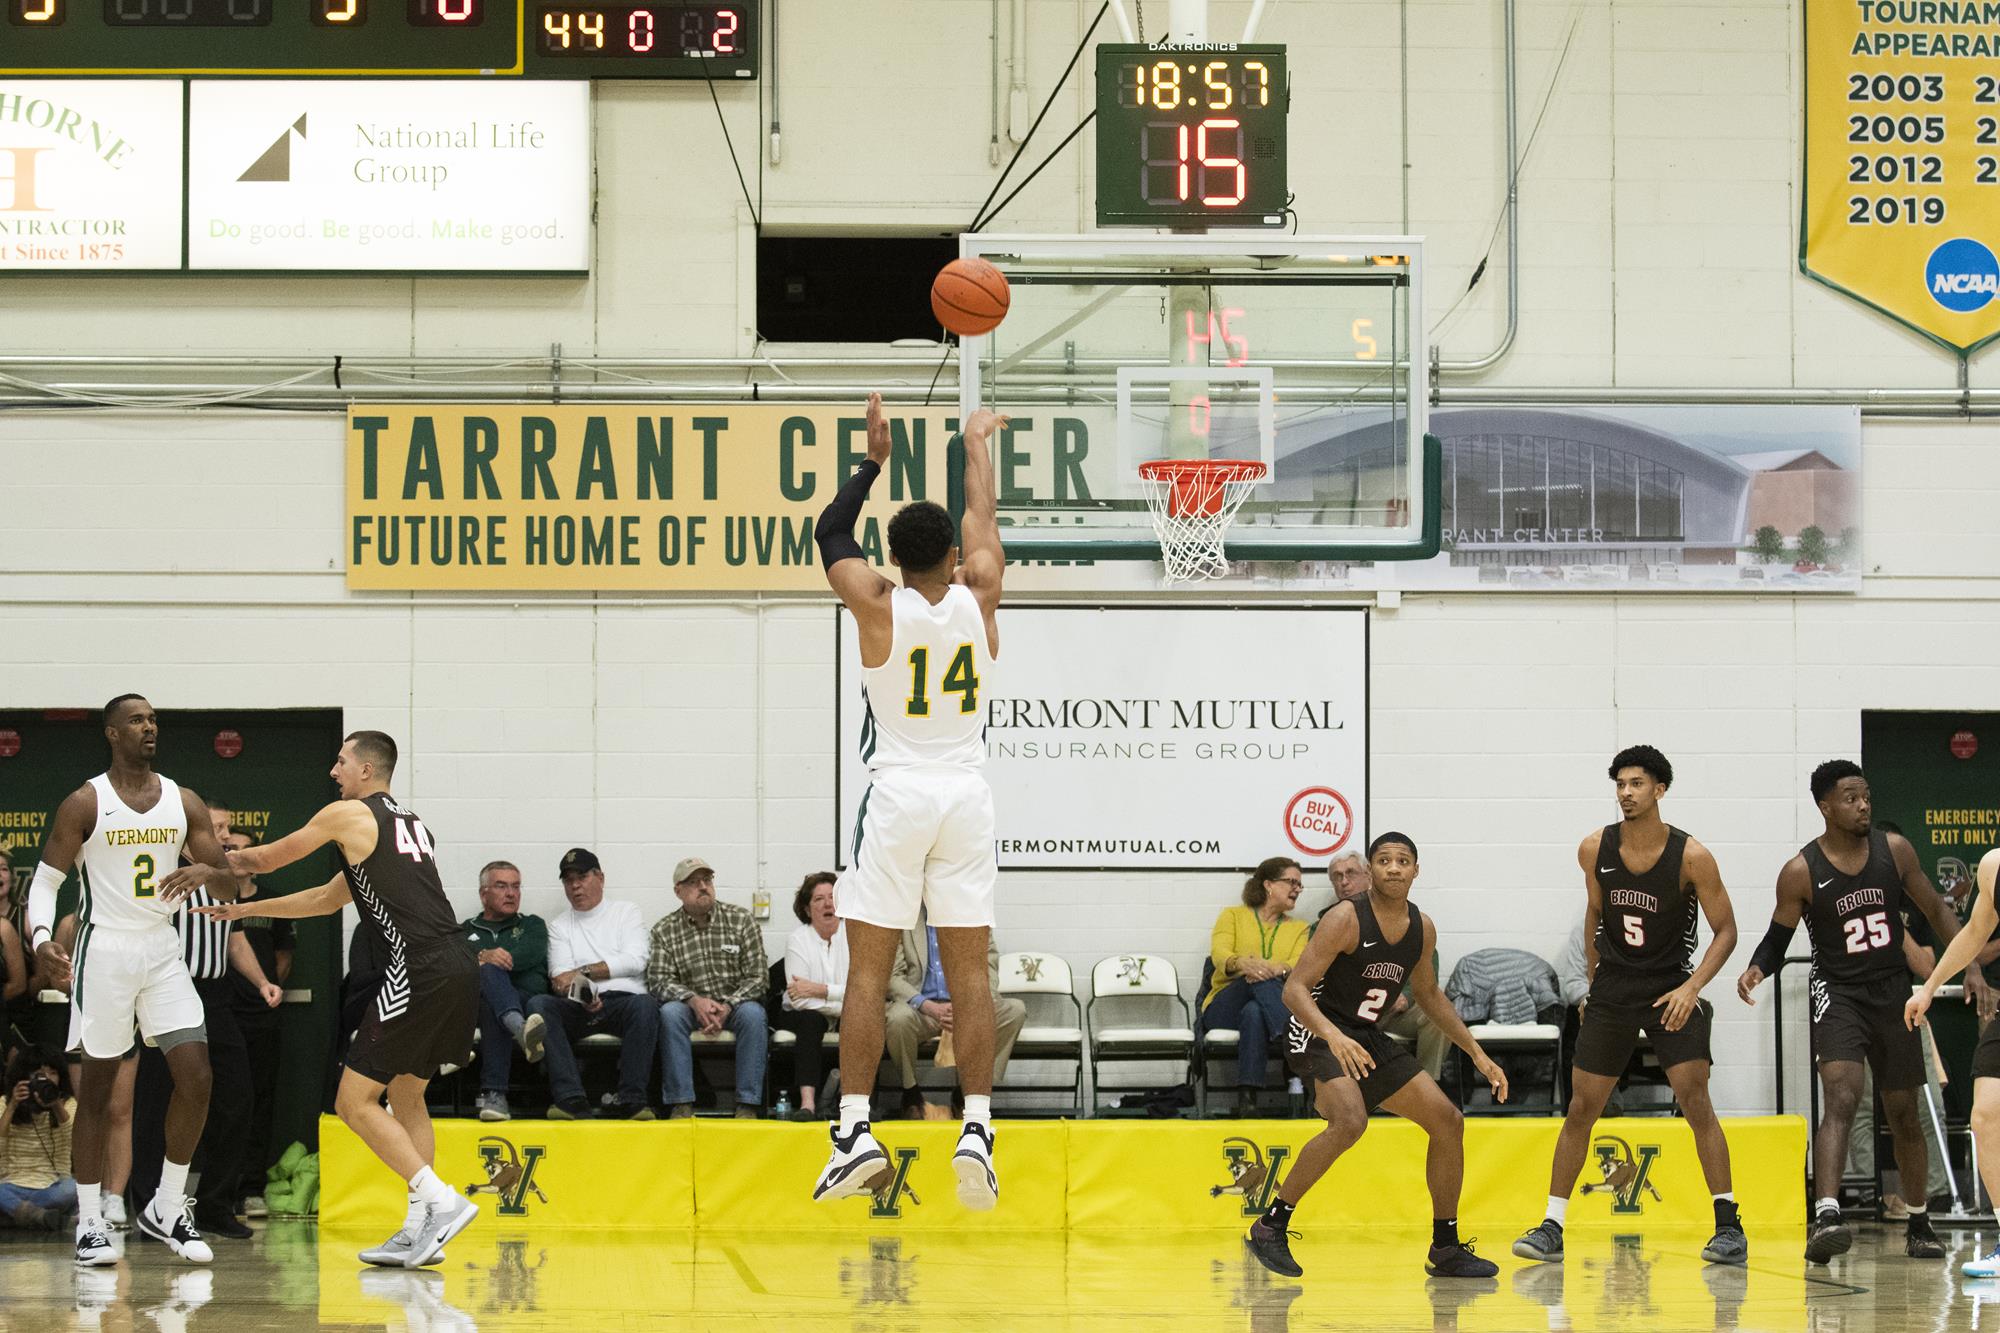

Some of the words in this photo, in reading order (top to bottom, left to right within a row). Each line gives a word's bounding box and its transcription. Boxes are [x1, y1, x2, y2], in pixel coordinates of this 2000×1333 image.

[544, 13, 604, 48] 44
[628, 10, 654, 52] 0
[712, 10, 738, 52] 2
[1149, 42, 1238, 51] DAKTRONICS
[1136, 61, 1269, 110] 18:57
[1849, 75, 1943, 101] 2003
[355, 122, 478, 149] National
[491, 122, 545, 149] Life
[1849, 116, 1944, 143] 2005
[353, 158, 448, 191] Group
[1177, 119, 1246, 206] 15
[1849, 156, 1942, 182] 2012
[1849, 197, 1945, 224] 2019
[209, 219, 241, 239] Do
[250, 219, 313, 245] good.
[322, 219, 350, 239] Be
[358, 219, 422, 245] good.
[431, 219, 493, 239] Make
[501, 219, 565, 245] good.
[15, 243, 69, 261] Since
[78, 243, 124, 261] 1875
[1933, 273, 1997, 294] NCAA
[352, 416, 729, 501] TARRANT
[779, 416, 1093, 501] CENER
[353, 516, 508, 566] FUTURE
[525, 516, 641, 566] HOME
[658, 516, 707, 566] OF
[725, 516, 813, 567] UVM
[1441, 528, 1502, 543] RANT
[1513, 528, 1604, 543] CENTER
[905, 643, 979, 718] 14
[986, 699, 1160, 729] ERMONT
[1171, 699, 1344, 730] MUTUAL
[987, 742, 1177, 759] INSURANCE
[1195, 742, 1309, 759] GROUP
[229, 811, 270, 827] GENCY
[1306, 800, 1335, 818] BUY
[1925, 809, 2000, 825] EMERGENCY
[106, 828, 178, 846] VERMONT
[1292, 815, 1341, 836] LOCAL
[1931, 829, 1959, 845] EXIT
[1964, 829, 1996, 845] ONLY
[394, 817, 436, 864] 44
[995, 840, 1221, 853] ERMONTMUTUAL.COM
[134, 854, 155, 898] 2
[1610, 889, 1657, 912] BROWN
[1836, 888, 1884, 916] BROWN
[1623, 914, 1645, 947] 5
[1843, 912, 1892, 953] 25
[1362, 963, 1404, 983] BROWN
[1357, 988, 1388, 1022] 2
